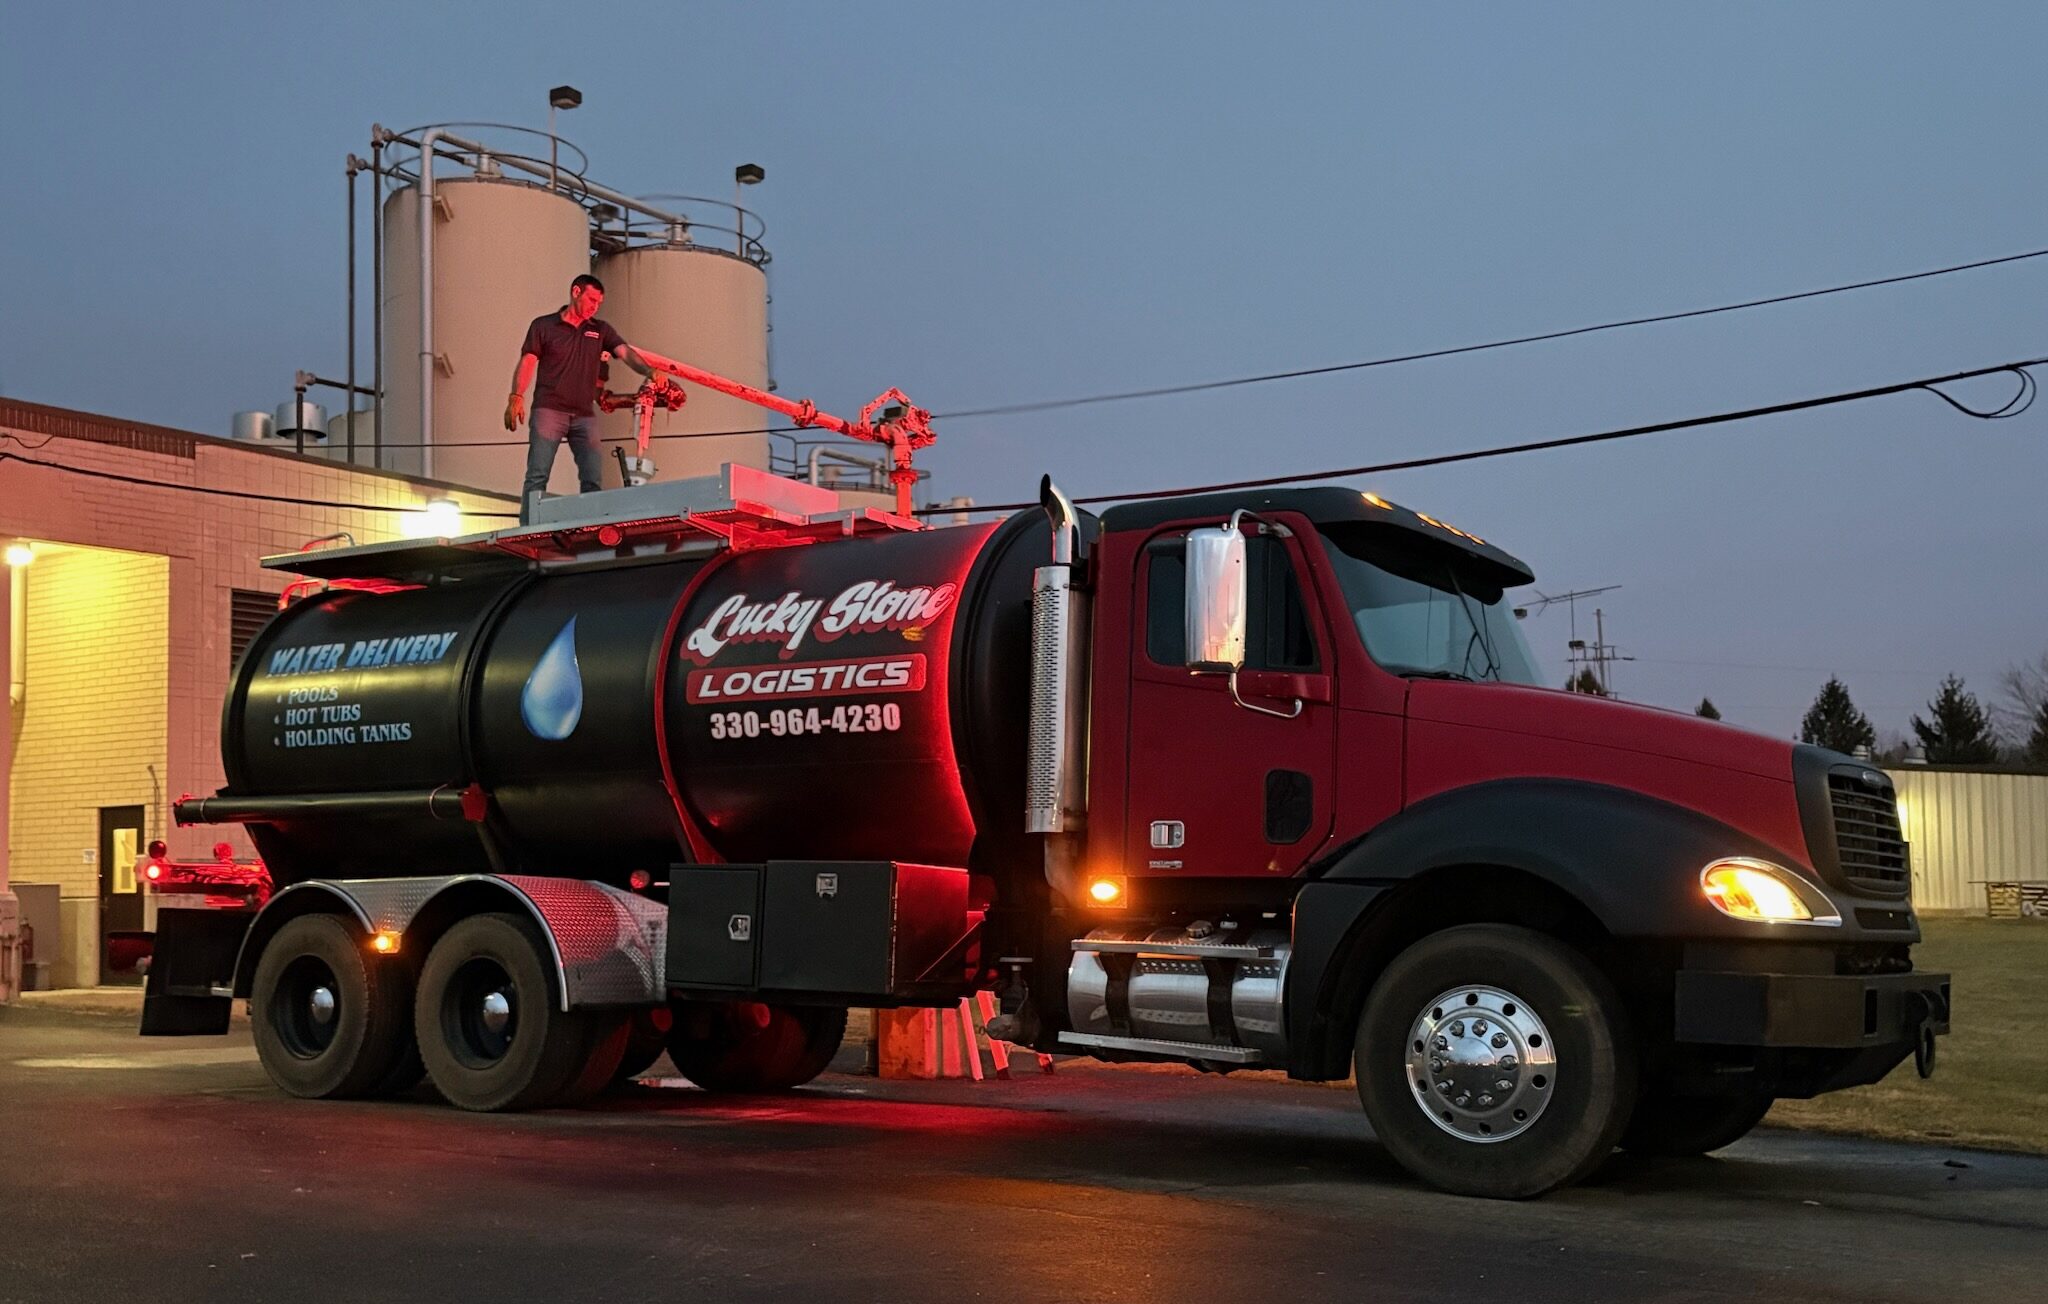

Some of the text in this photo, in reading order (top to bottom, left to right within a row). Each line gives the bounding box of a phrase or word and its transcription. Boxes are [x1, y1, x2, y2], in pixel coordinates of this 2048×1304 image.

[687, 580, 954, 658] Lucky Stone
[268, 631, 458, 677] WATER DELIVERY
[288, 687, 339, 704] POOLS
[698, 661, 912, 697] LOGISTICS
[285, 704, 361, 725] HOT TUBS
[710, 702, 901, 740] 330-964-4230
[285, 722, 413, 747] HOLDING TANKS
